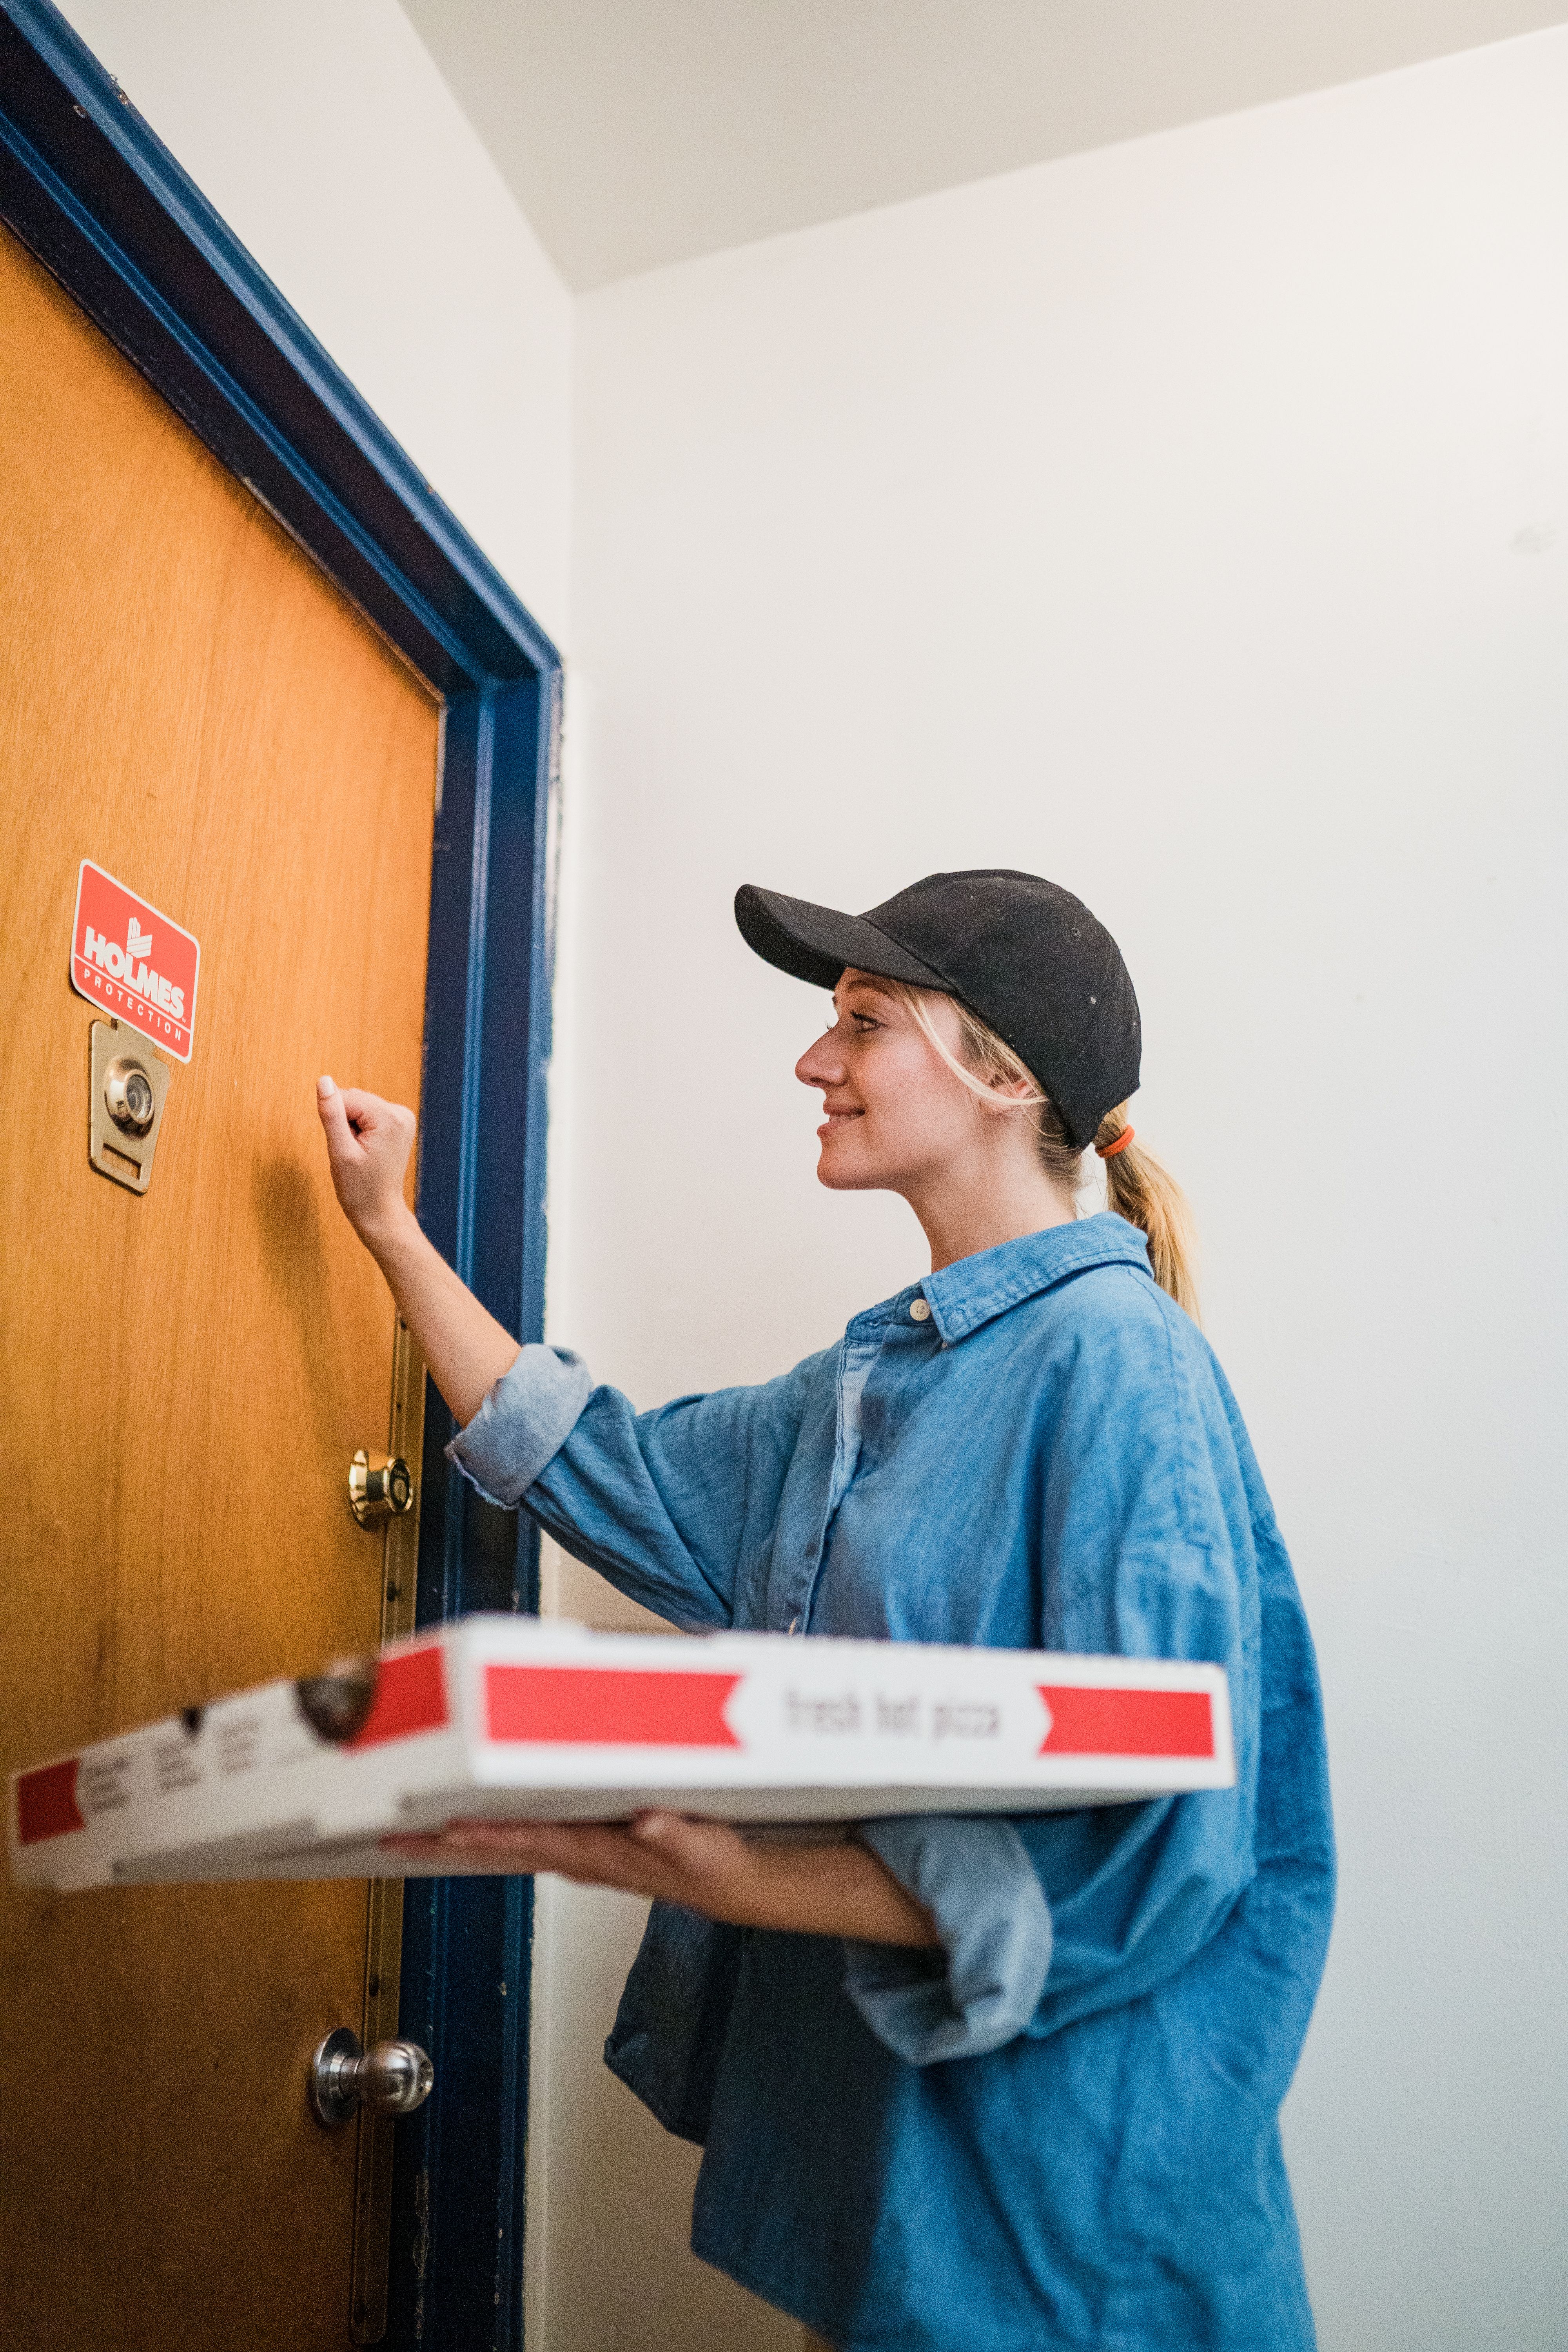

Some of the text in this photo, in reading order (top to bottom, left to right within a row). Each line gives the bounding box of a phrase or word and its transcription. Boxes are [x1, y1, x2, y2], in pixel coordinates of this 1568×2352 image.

[84, 926, 185, 1019] HOLMES
[84, 969, 181, 1041] PROTECTION
[931, 1694, 1002, 1744] pizza
